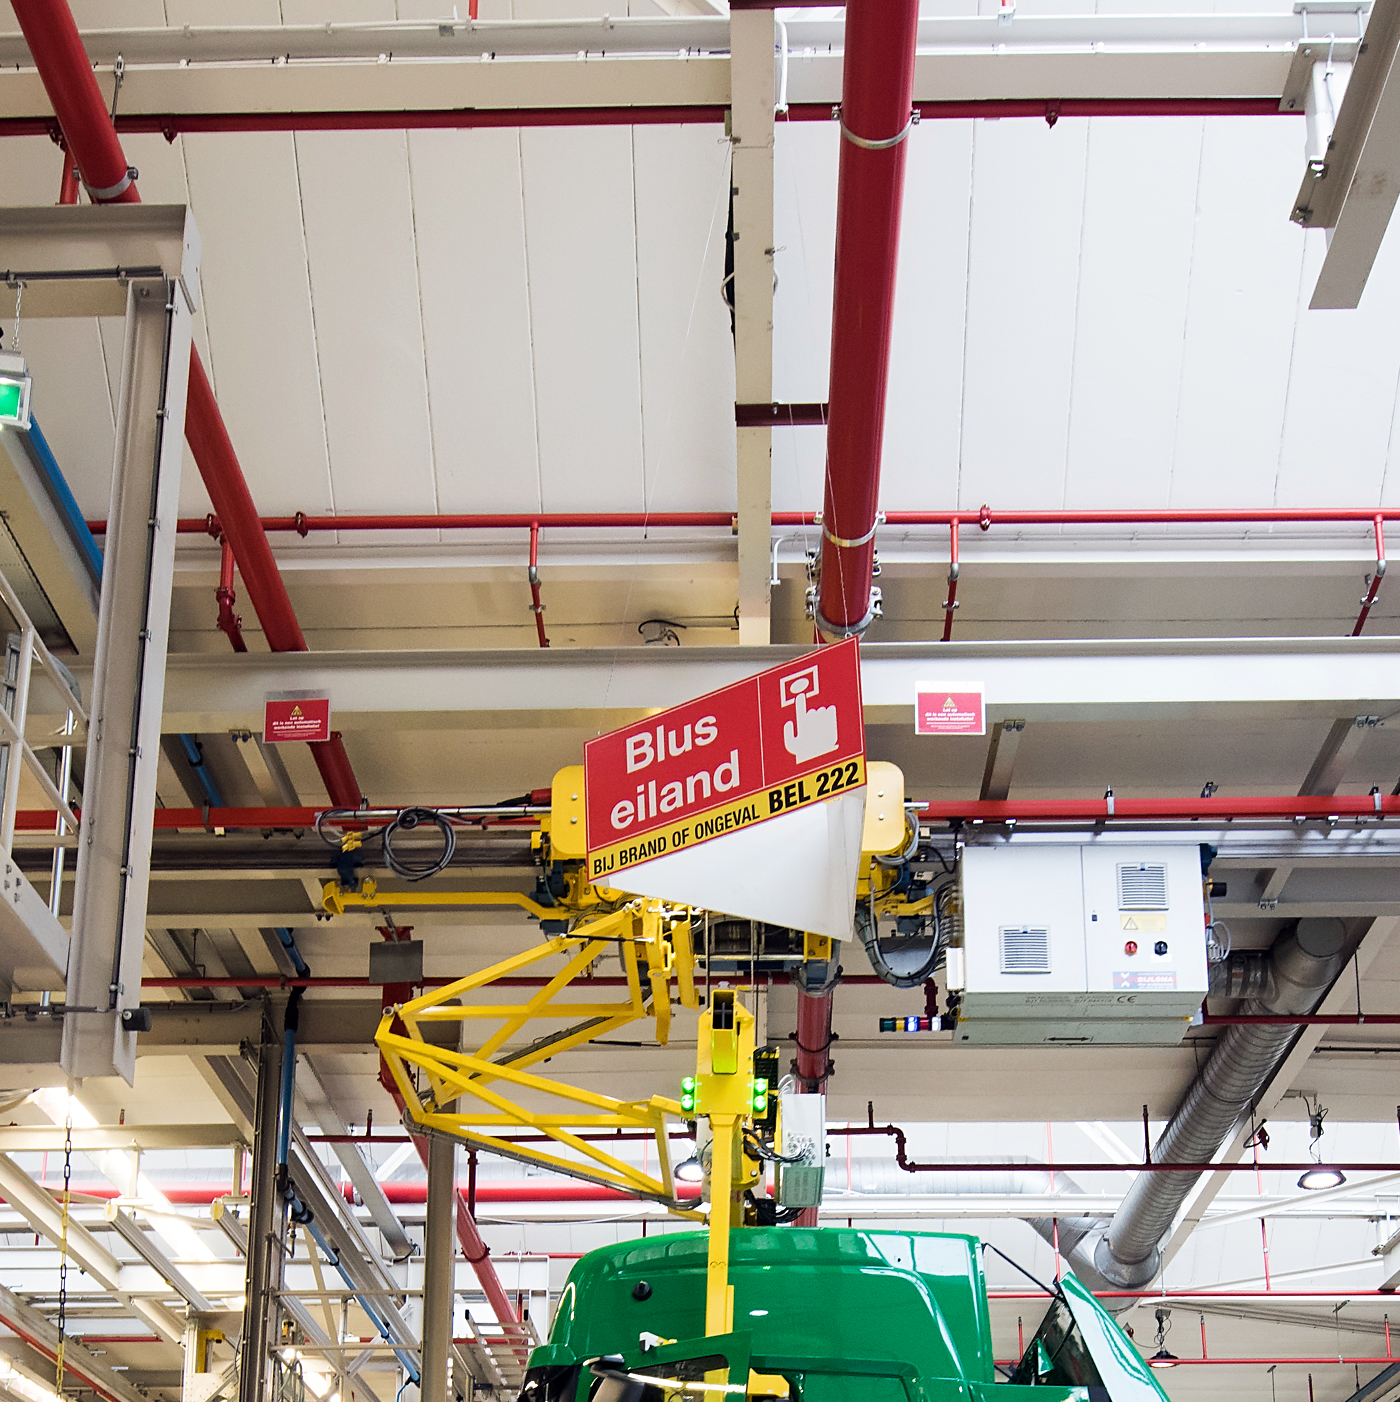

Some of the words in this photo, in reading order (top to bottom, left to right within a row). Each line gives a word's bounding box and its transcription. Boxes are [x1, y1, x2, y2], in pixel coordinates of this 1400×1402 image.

[625, 714, 718, 775] Blus
[593, 853, 615, 875] BIJ
[618, 835, 667, 867] BRAND
[672, 827, 690, 848] OF
[694, 803, 760, 841] ONGEVAL
[768, 779, 811, 814] BEL
[815, 761, 860, 797] 222
[610, 748, 741, 830] eiland
